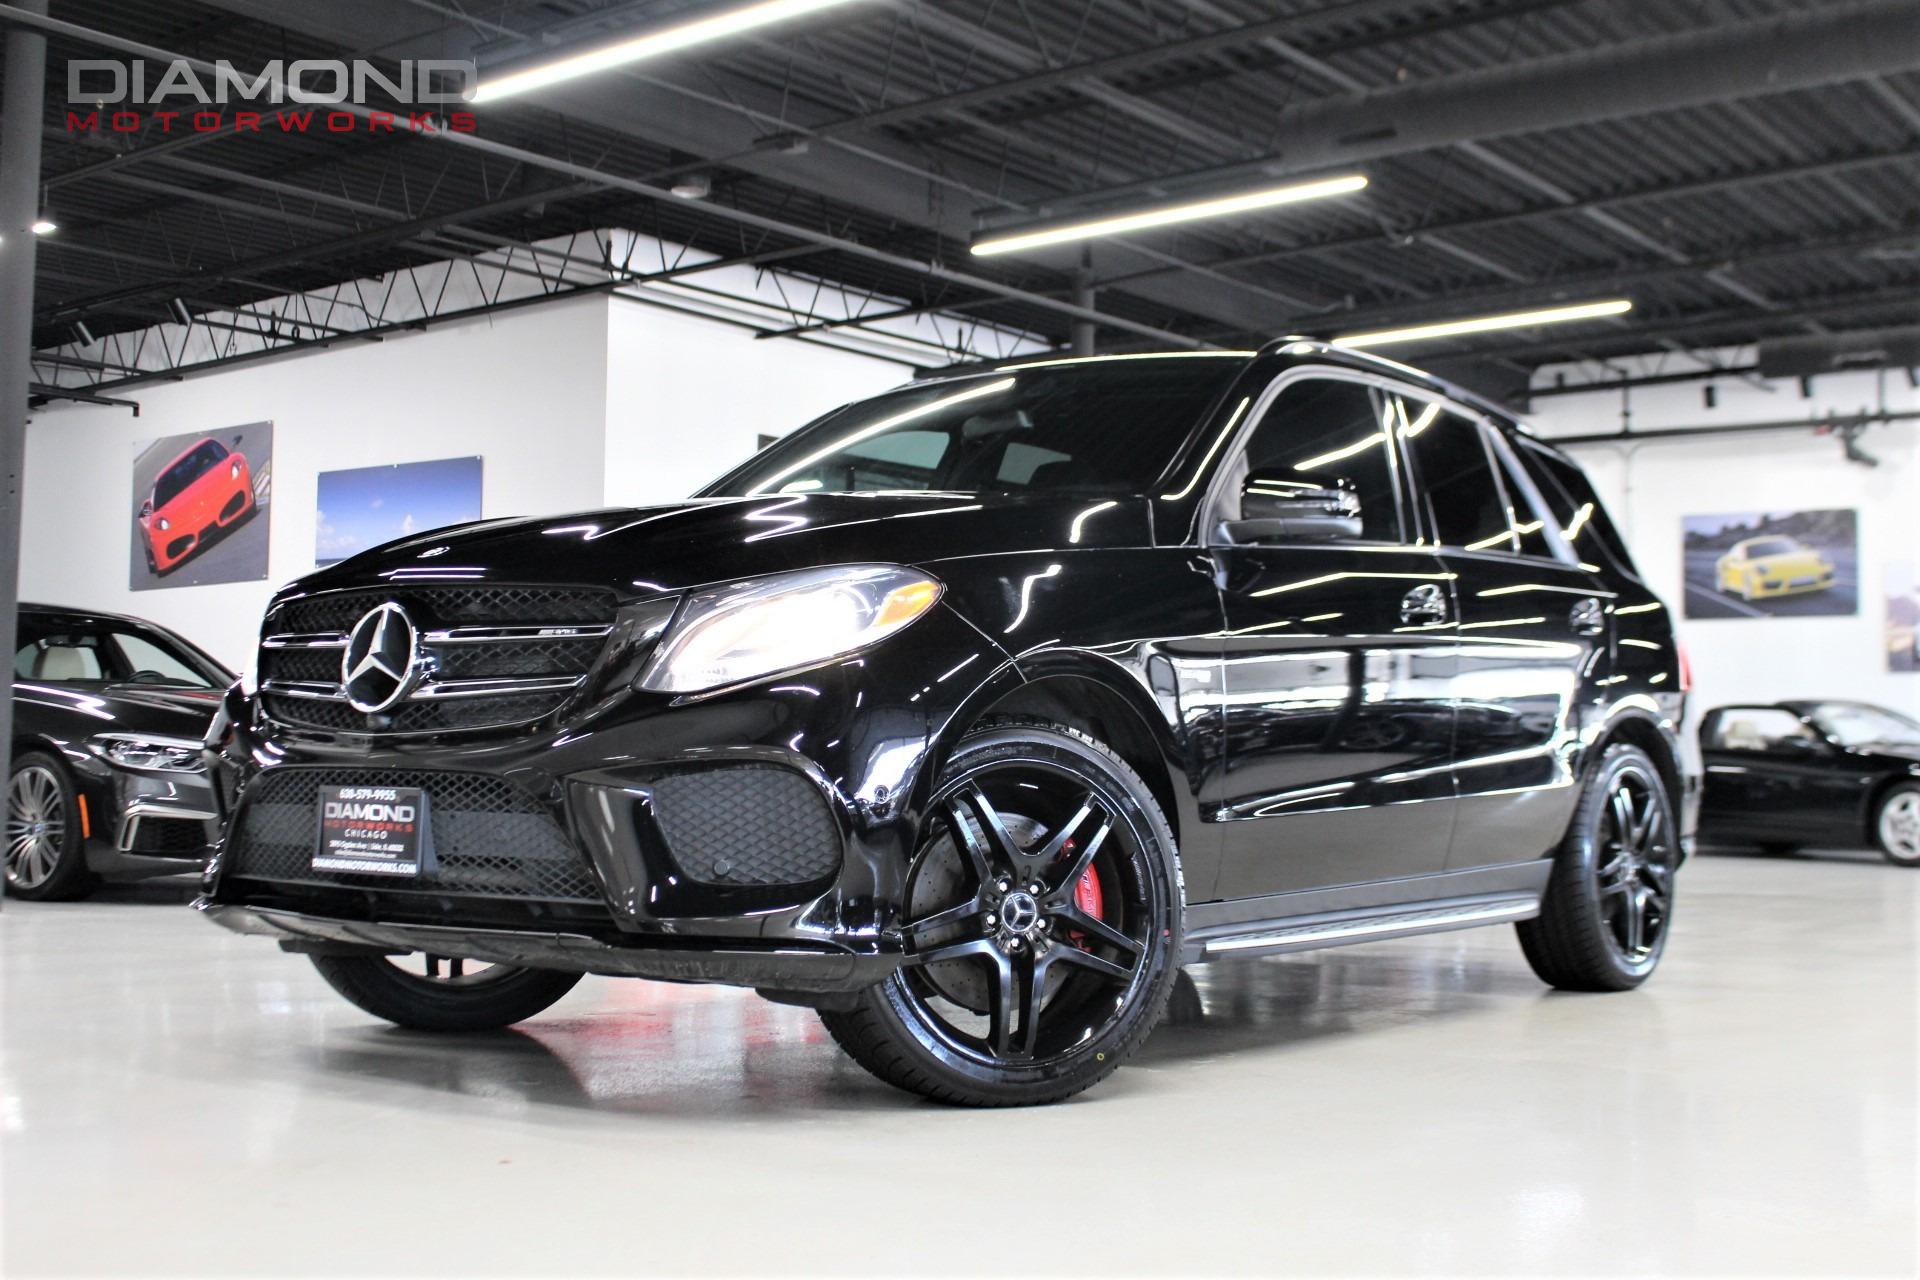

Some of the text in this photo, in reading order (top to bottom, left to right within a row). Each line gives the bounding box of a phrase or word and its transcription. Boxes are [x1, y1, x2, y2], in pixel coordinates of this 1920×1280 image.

[324, 802, 415, 822] DIAMOND
[323, 820, 414, 833] MOTORWORKS
[344, 828, 388, 839] CHICAGO
[312, 857, 417, 874] DIAMONDMOTORWORKS.COM
